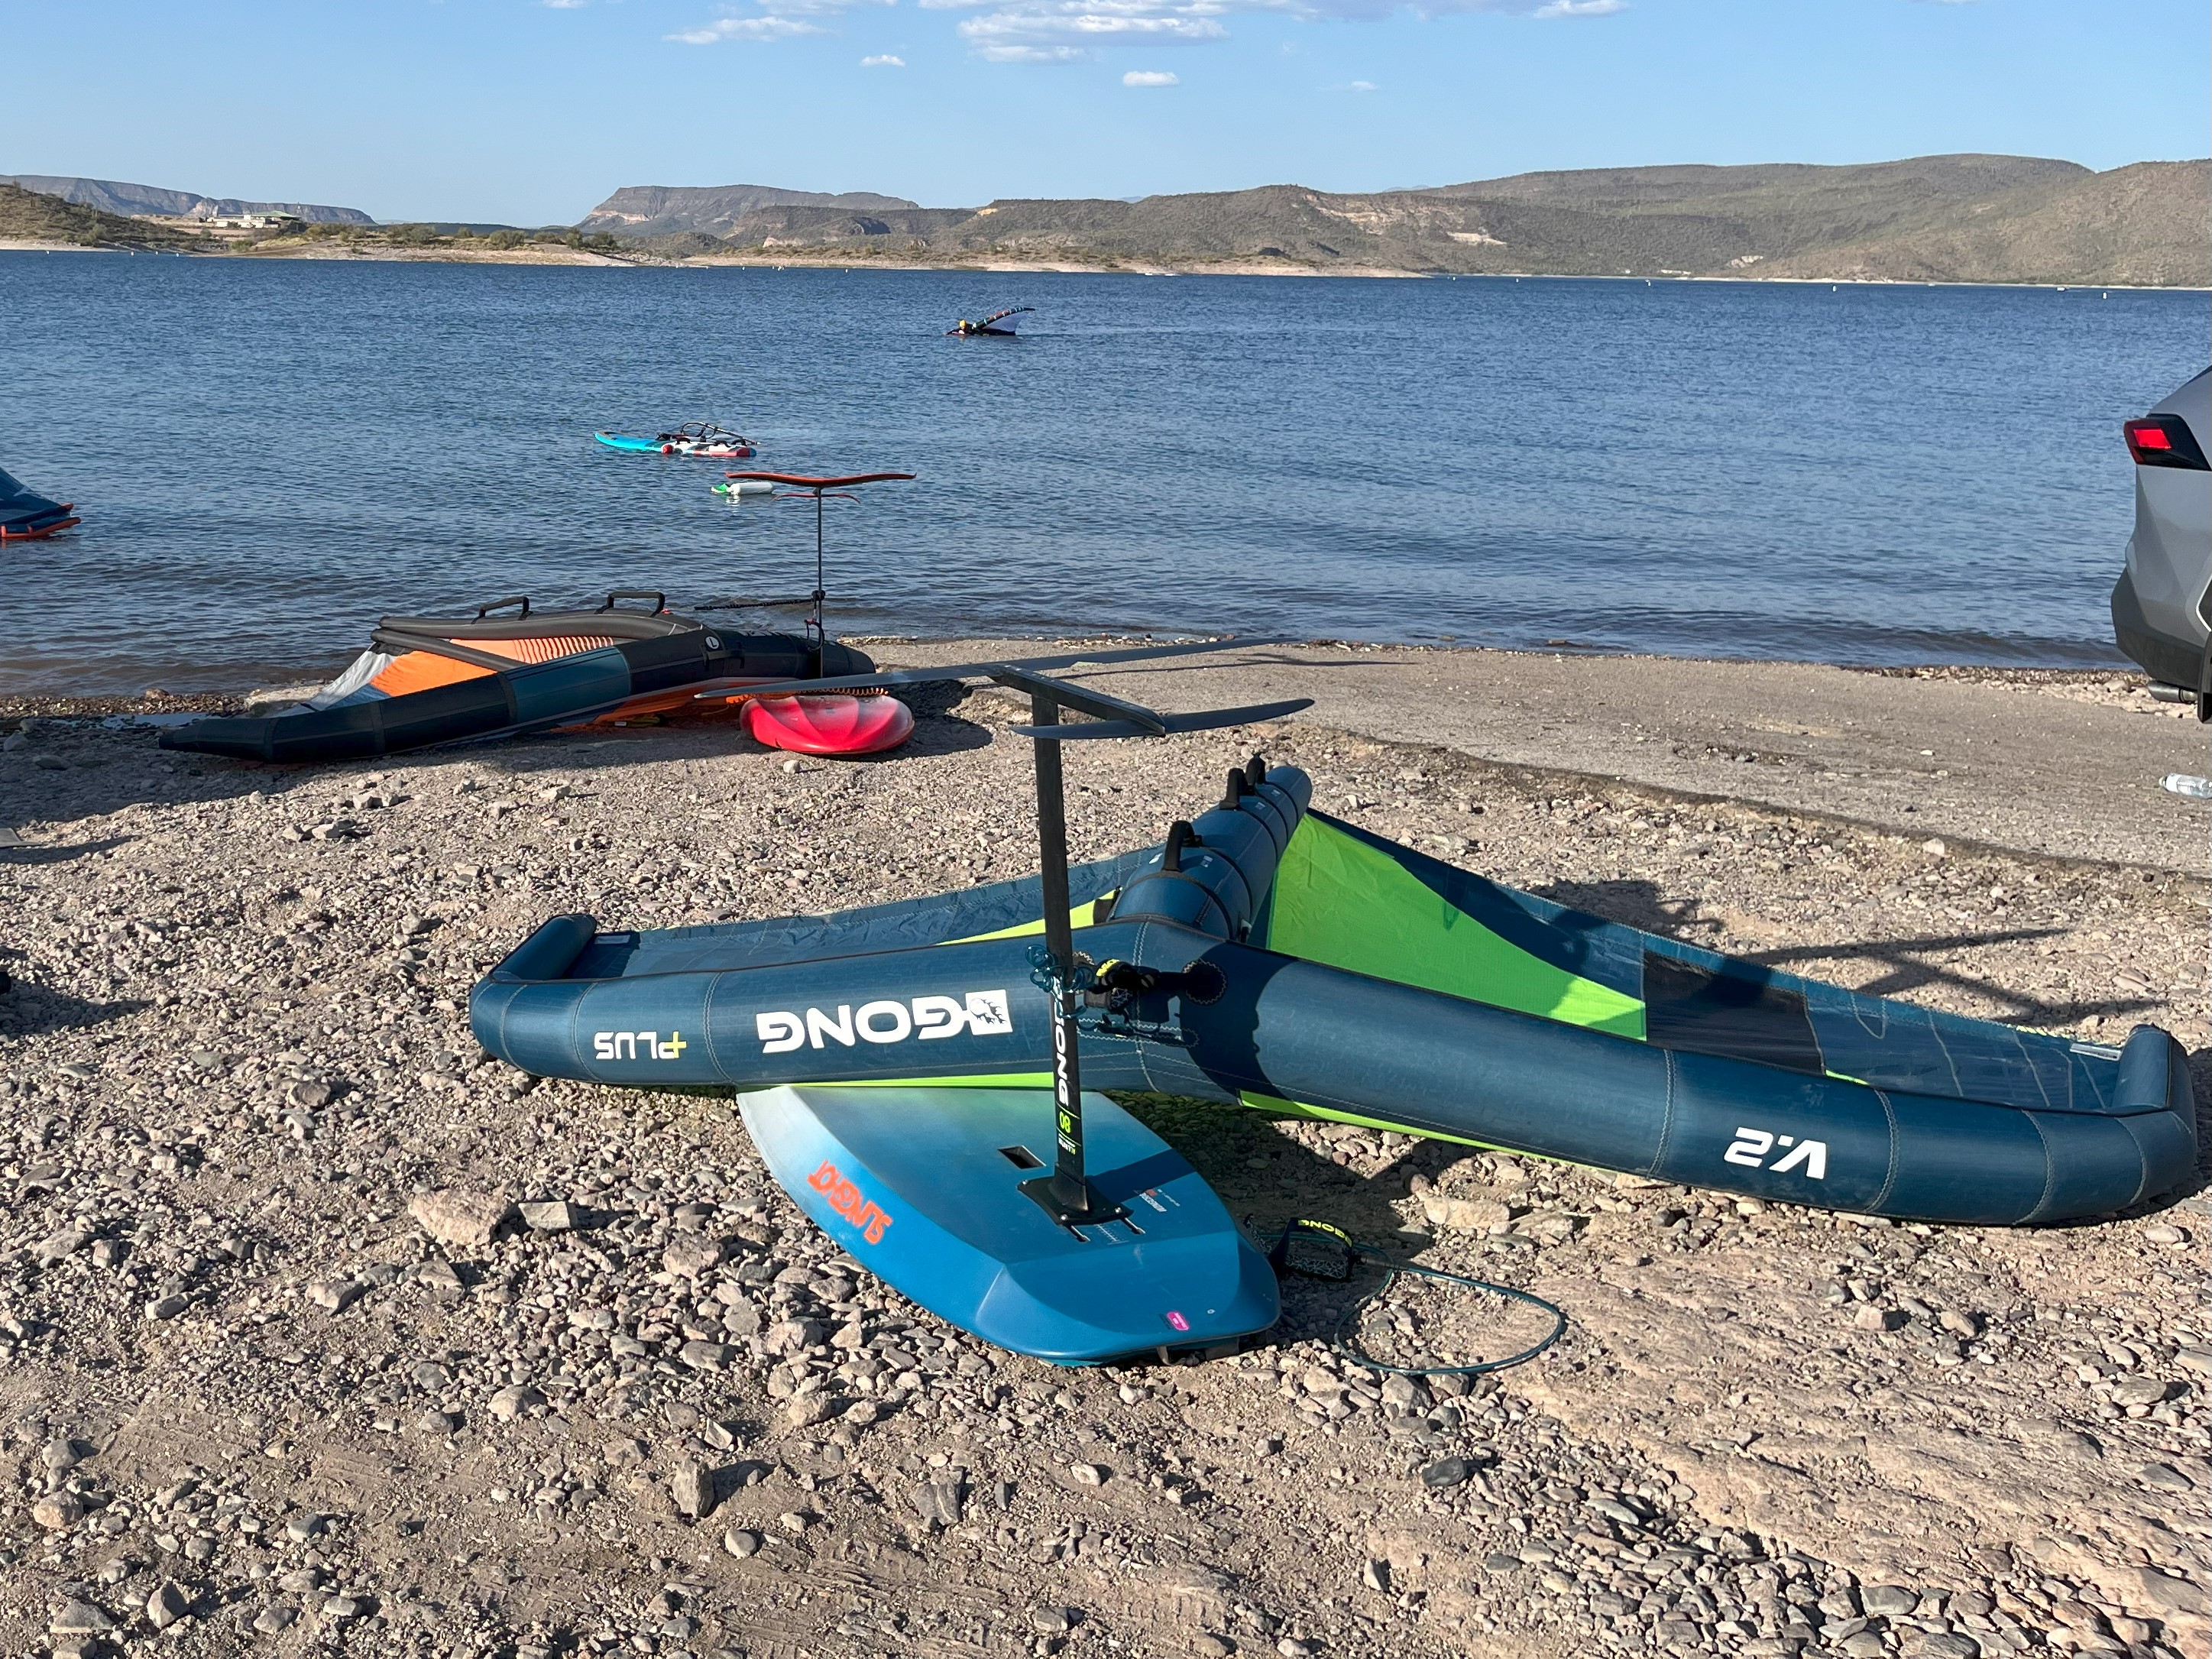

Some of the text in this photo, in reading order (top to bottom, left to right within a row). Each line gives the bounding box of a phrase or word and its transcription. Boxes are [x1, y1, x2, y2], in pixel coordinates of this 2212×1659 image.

[594, 1031, 687, 1060] PLUS
[756, 995, 967, 1054] GONG
[1724, 1126, 1826, 1180] V.2
